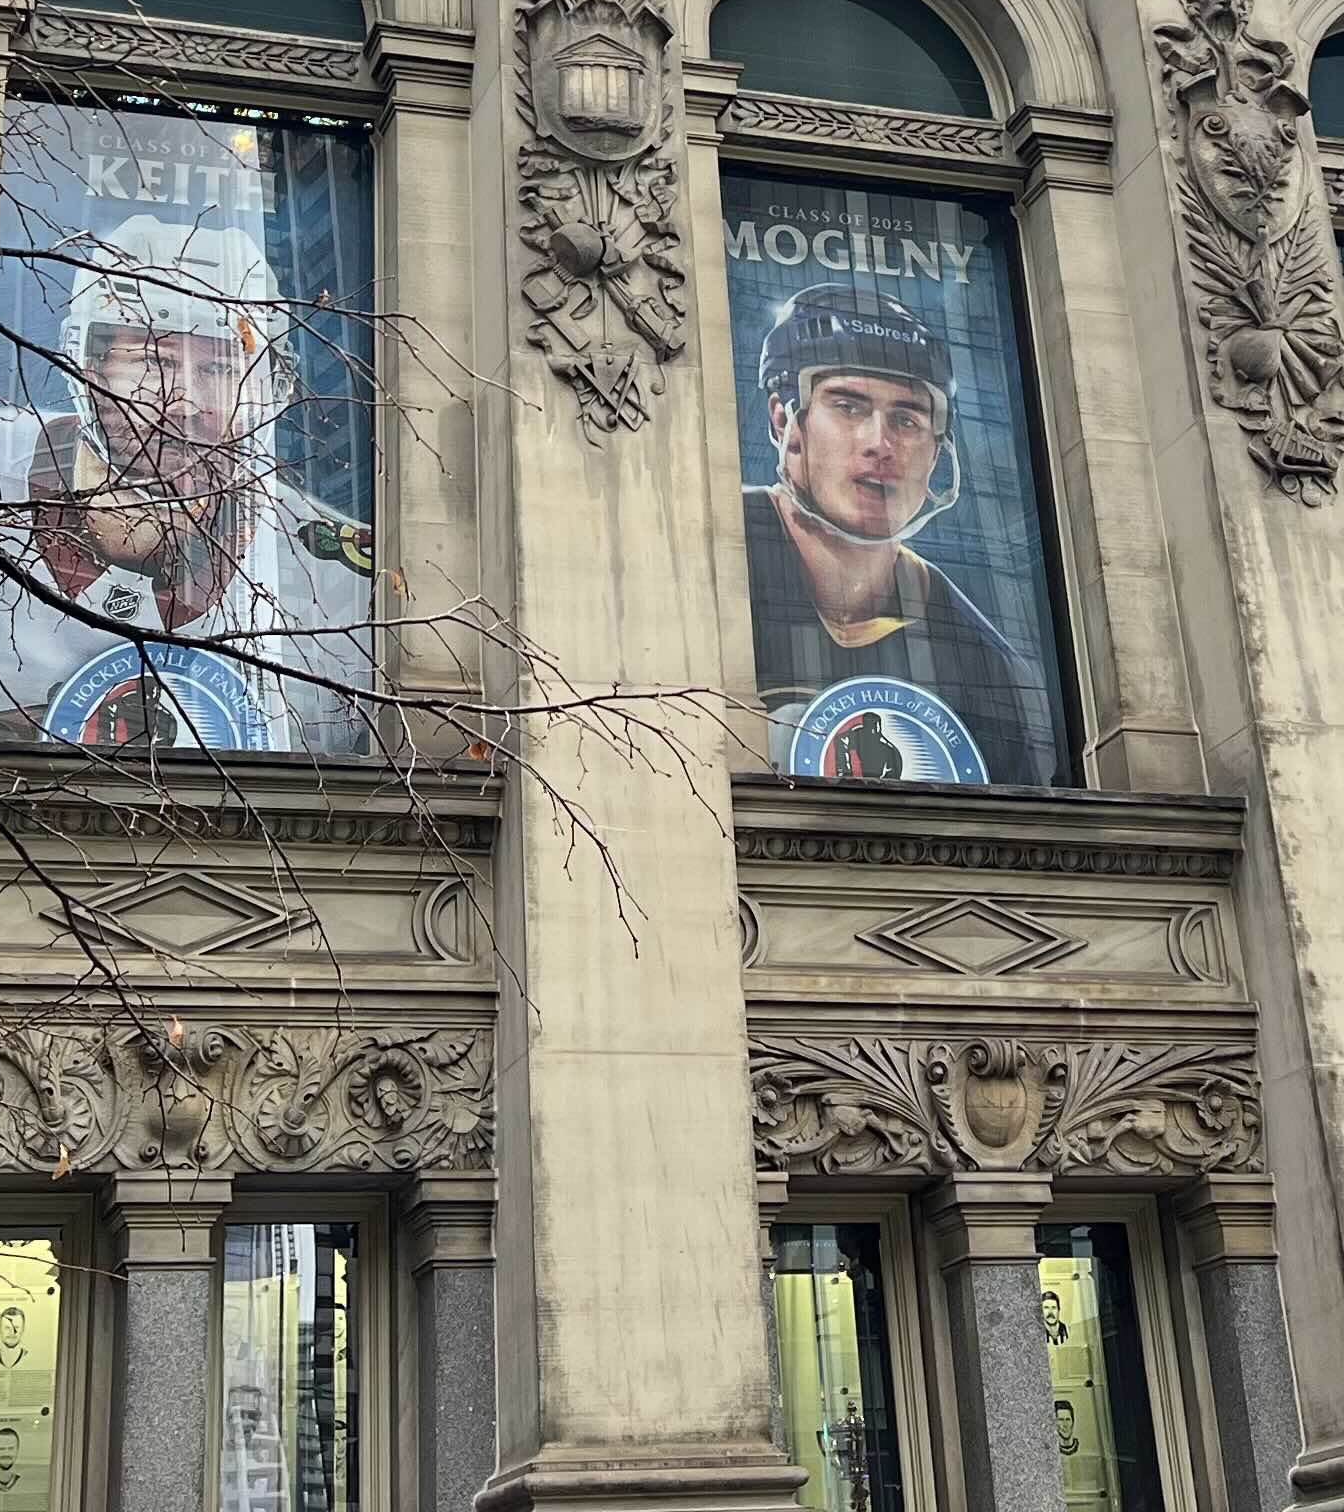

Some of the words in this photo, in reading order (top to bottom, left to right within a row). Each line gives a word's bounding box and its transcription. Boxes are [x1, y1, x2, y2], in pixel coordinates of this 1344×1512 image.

[98, 134, 172, 154] CLASS
[180, 142, 207, 159] OF
[85, 153, 278, 214] KEITH
[768, 204, 832, 224] CLASS
[838, 211, 865, 226] OF
[871, 216, 914, 233] 2025
[722, 218, 974, 284] MOGILNY
[850, 319, 911, 343] Sabres
[69, 654, 134, 709] HOCKEY
[191, 662, 210, 678] of
[861, 690, 905, 706] HALL
[906, 700, 922, 713] of
[923, 706, 962, 748] FAME
